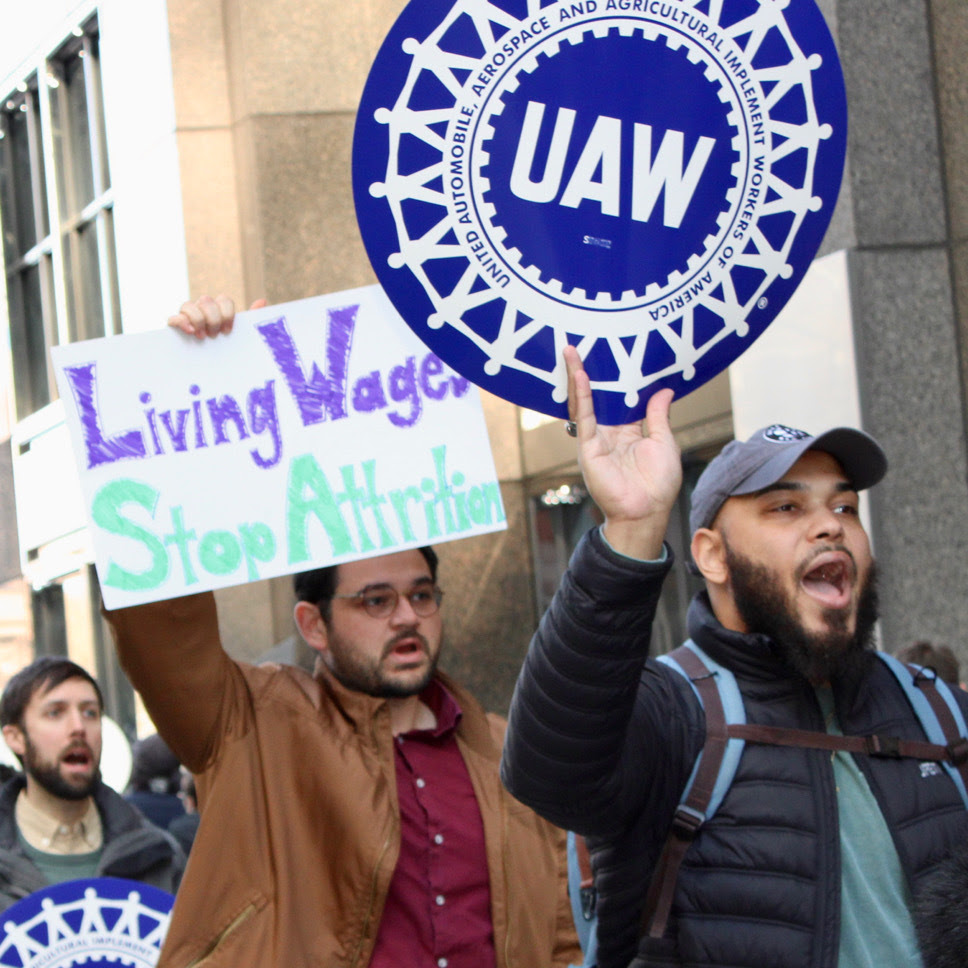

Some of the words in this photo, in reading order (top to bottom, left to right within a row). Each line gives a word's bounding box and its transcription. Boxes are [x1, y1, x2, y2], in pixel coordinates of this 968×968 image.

[559, 0, 598, 22] AND
[606, 0, 721, 52] AGRICULTURAL
[473, 17, 551, 98] AEROSPACE
[722, 50, 766, 146] IMPLEMENT
[449, 101, 475, 225] AUTOMOBILE,
[509, 100, 717, 229] UAW
[732, 155, 766, 242] WORKERS
[464, 229, 511, 288] UNITED
[648, 272, 714, 322] AMERICA
[716, 247, 734, 270] OF
[63, 361, 282, 469] Living
[91, 476, 277, 593] Stop
[287, 444, 505, 566] Attrition
